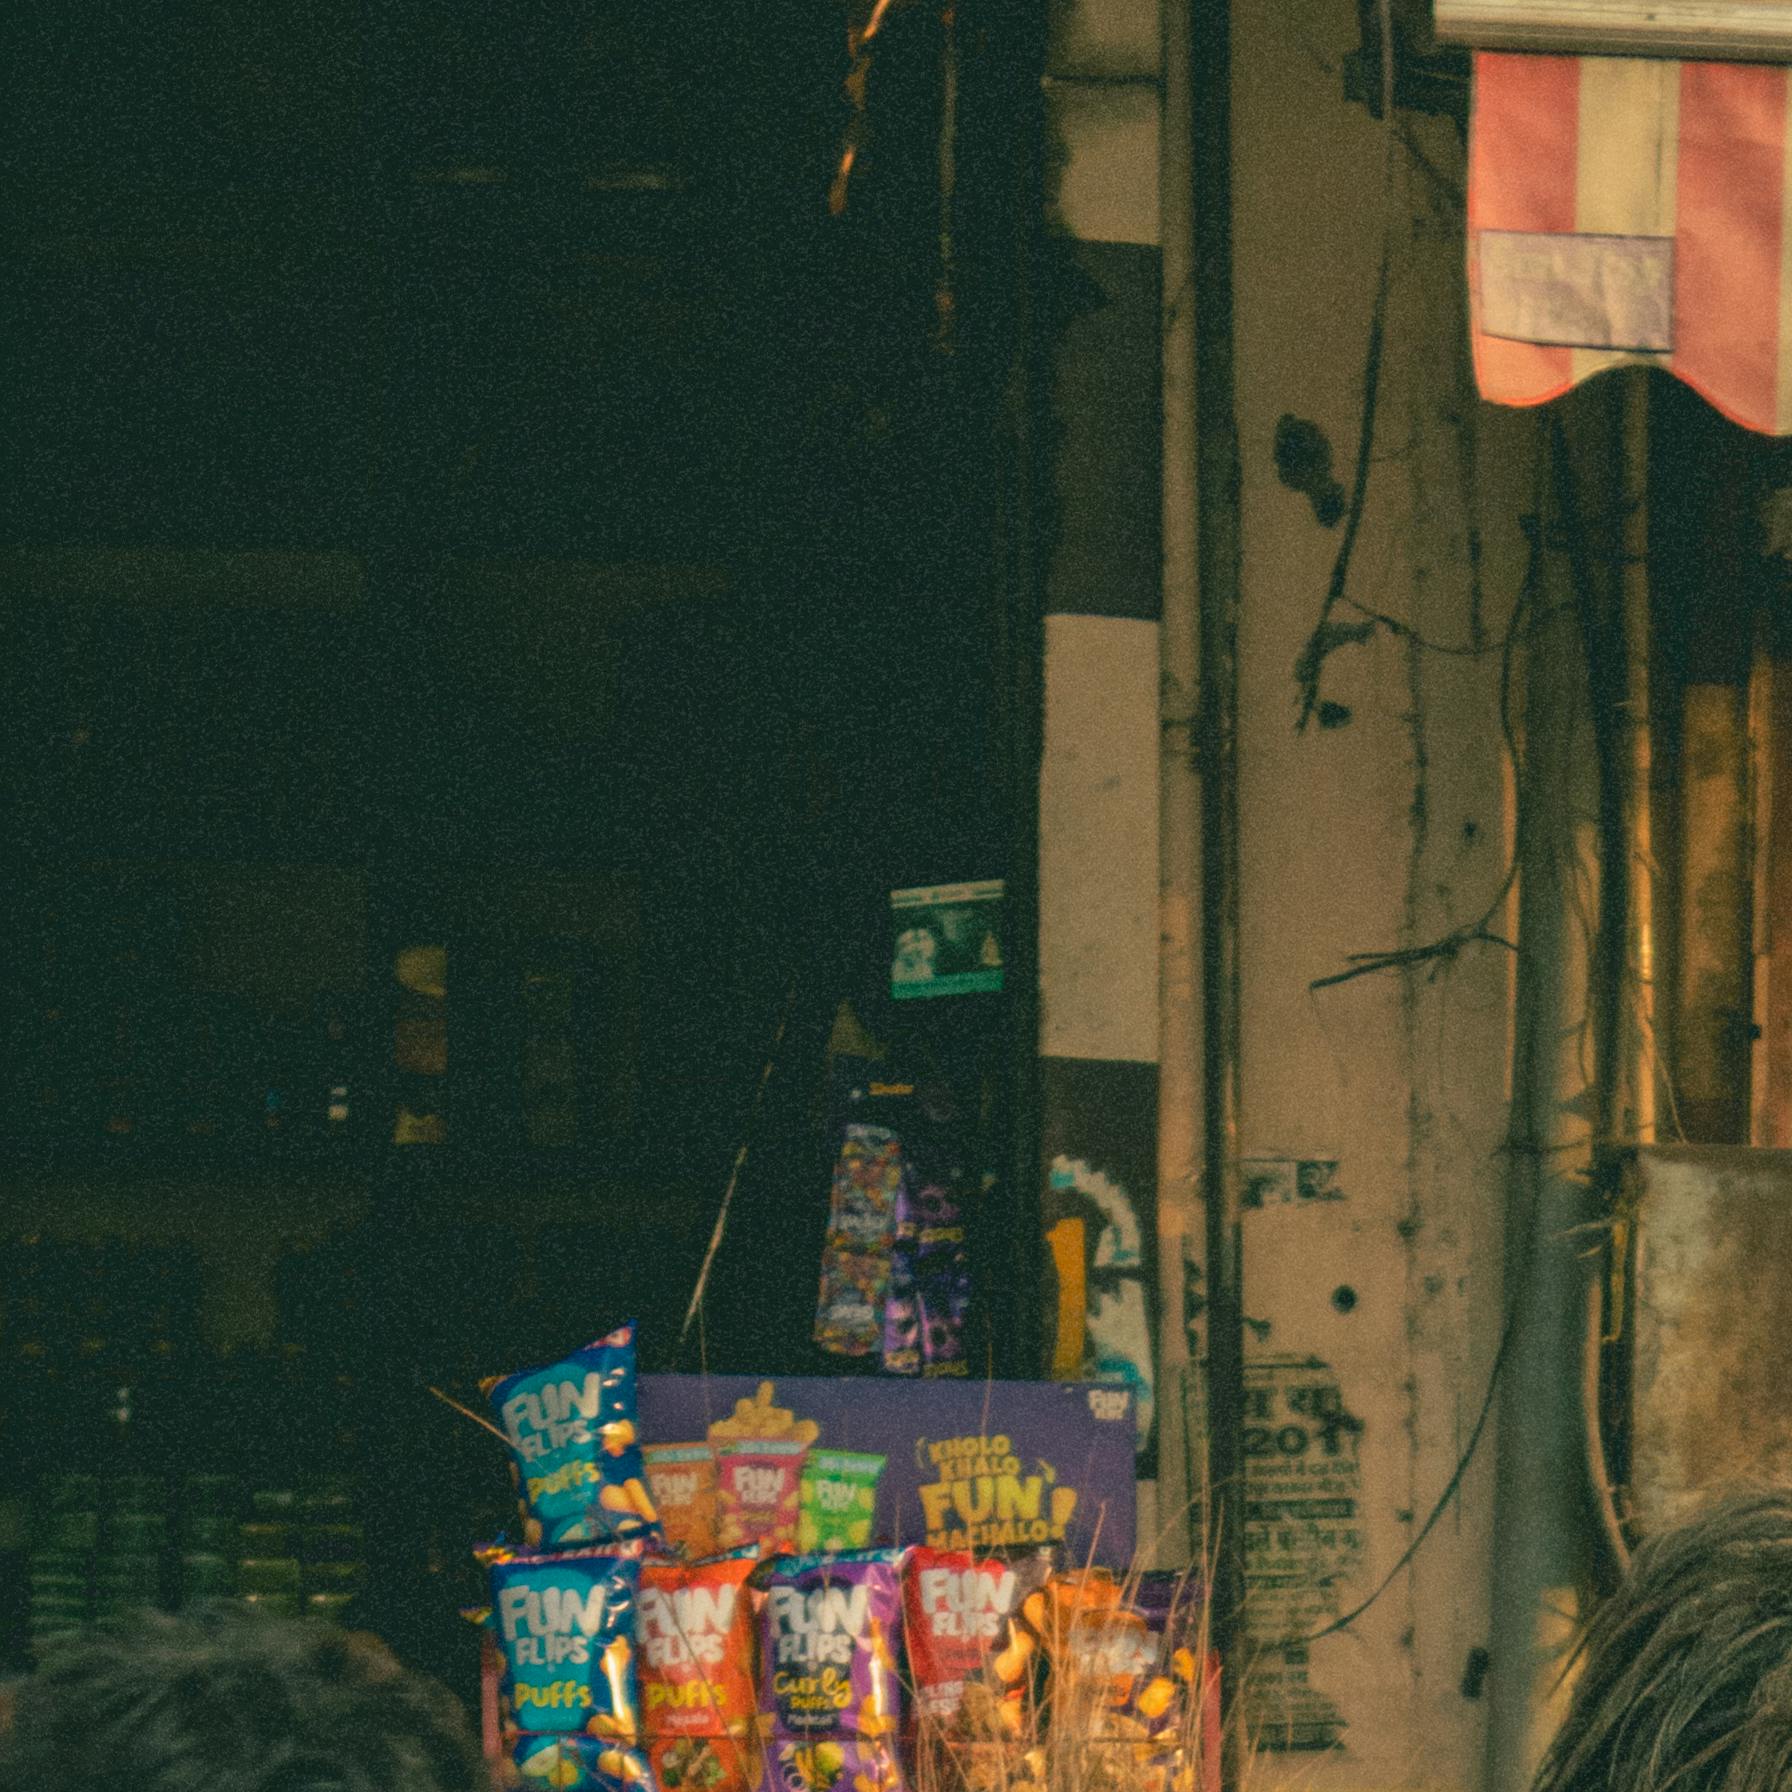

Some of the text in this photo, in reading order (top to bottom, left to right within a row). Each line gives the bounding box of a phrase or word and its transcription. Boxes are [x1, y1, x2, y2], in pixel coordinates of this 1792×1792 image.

[503, 1372, 600, 1448] FUN
[500, 1584, 606, 1640] FUN
[770, 1584, 868, 1640] FUN
[920, 1568, 1017, 1614] FUN
[638, 1583, 736, 1645] FUN
[932, 1611, 999, 1637] FLIPS
[515, 1632, 591, 1666] FLIPS
[646, 1633, 724, 1669] FLIPS
[778, 1632, 852, 1665] FLIPS
[774, 1667, 853, 1708] Curly
